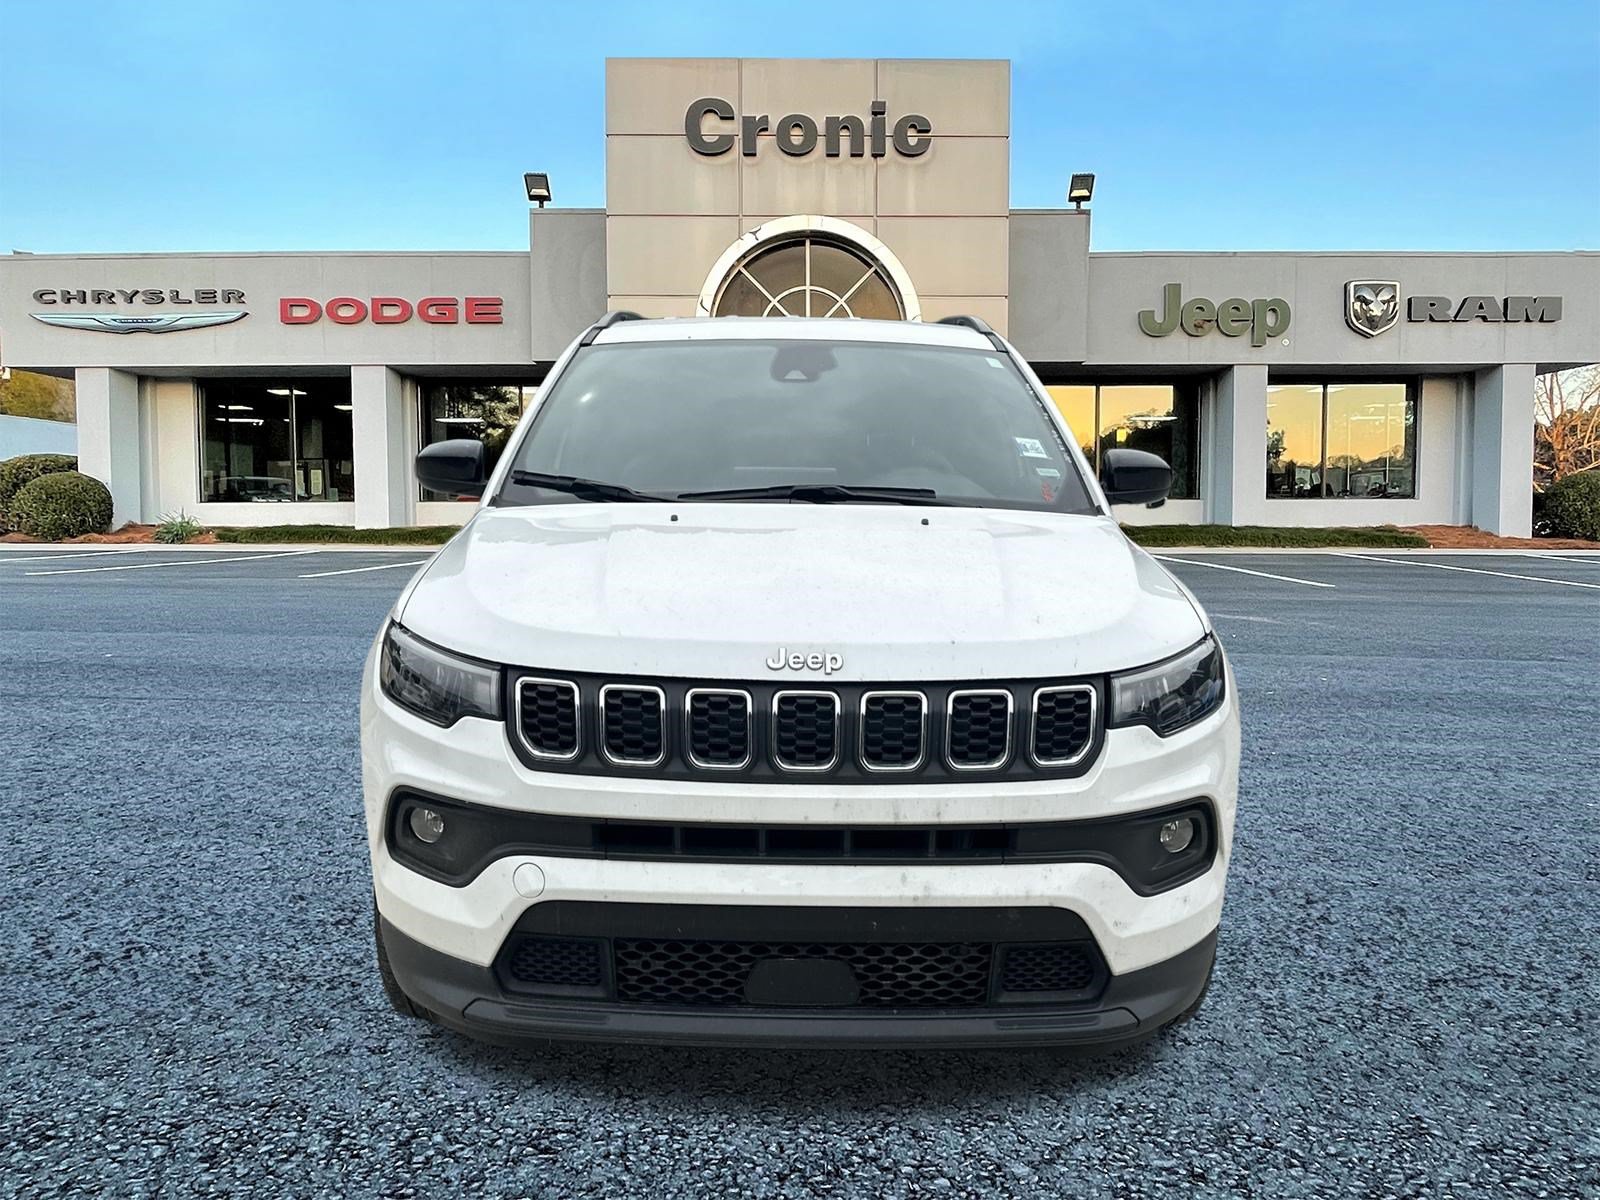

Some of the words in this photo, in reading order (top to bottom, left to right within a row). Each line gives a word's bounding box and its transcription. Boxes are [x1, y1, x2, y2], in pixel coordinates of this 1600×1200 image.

[685, 98, 932, 157] Cronic
[32, 287, 247, 305] CHRYSLER
[1407, 296, 1563, 323] RAM
[280, 297, 504, 325] DODGE
[1138, 283, 1291, 347] Jeep
[766, 647, 844, 675] Jeep
